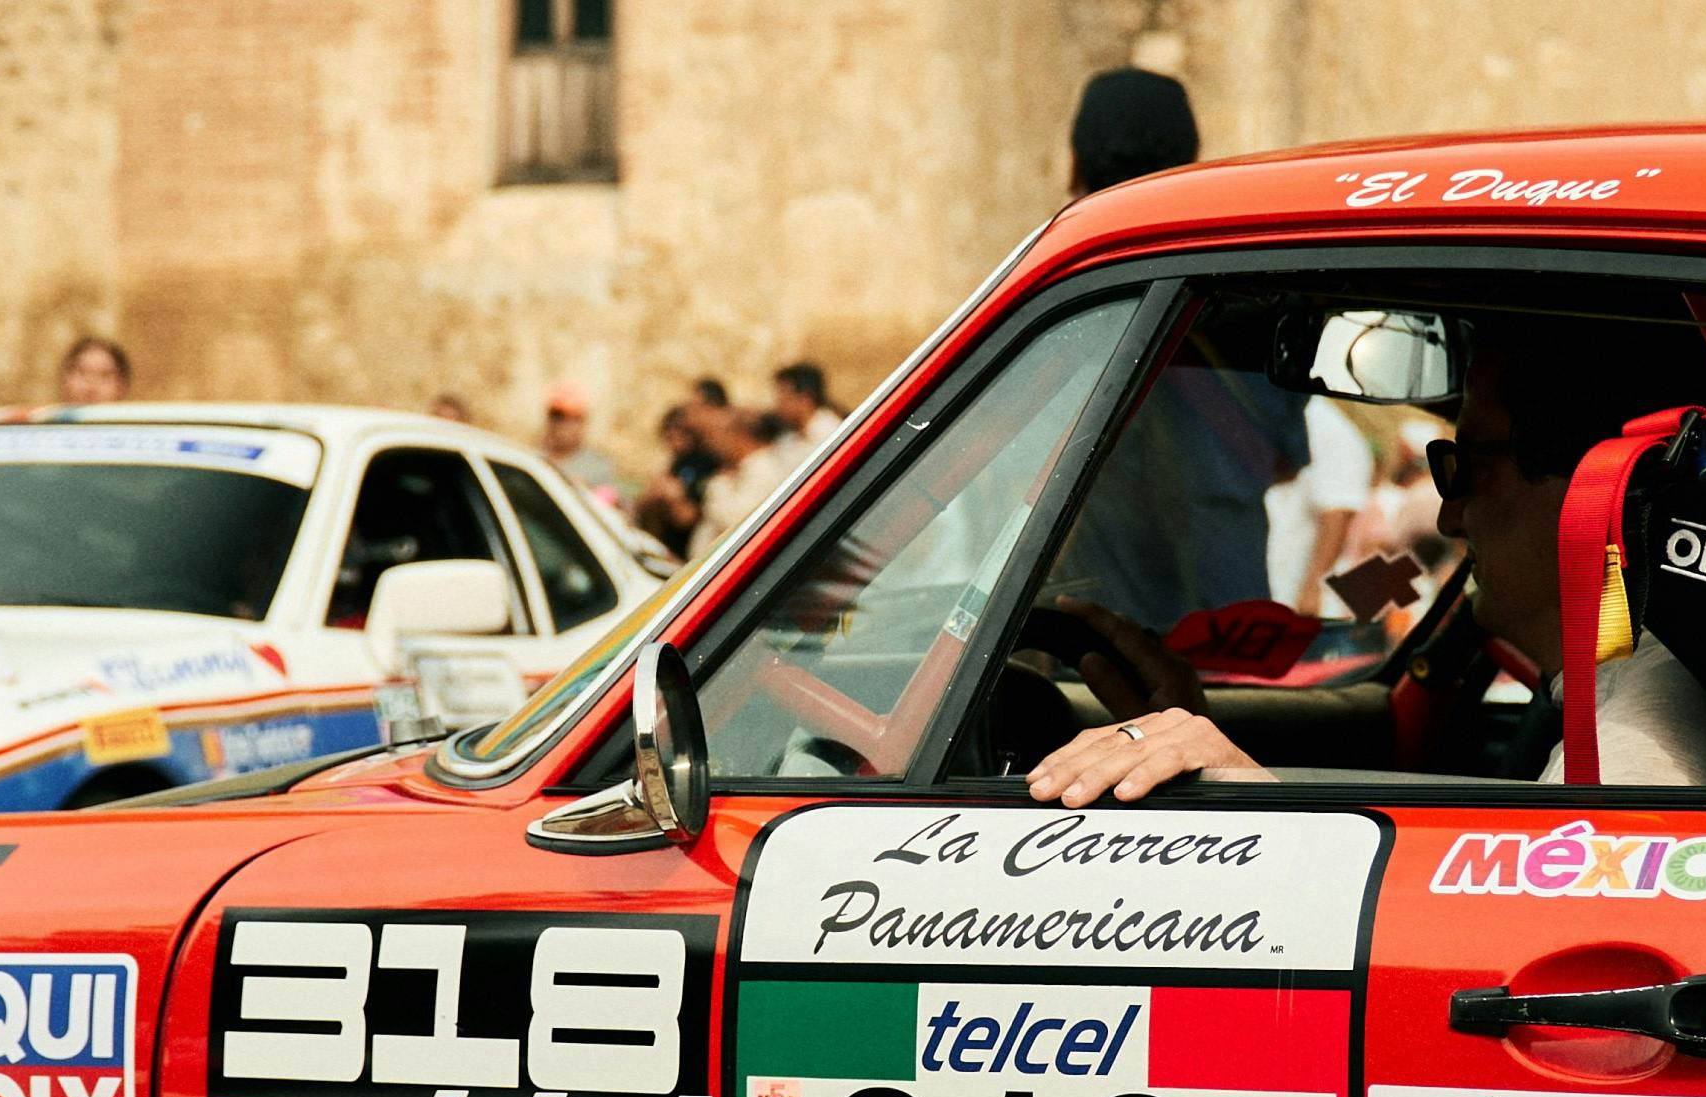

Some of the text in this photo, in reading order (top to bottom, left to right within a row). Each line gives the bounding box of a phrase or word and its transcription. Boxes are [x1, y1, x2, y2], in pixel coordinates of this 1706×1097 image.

[874, 813, 1261, 877] La Carrera
[812, 879, 1264, 955] Panamericana
[222, 920, 687, 1095] 318
[921, 1001, 1143, 1076] telcel
